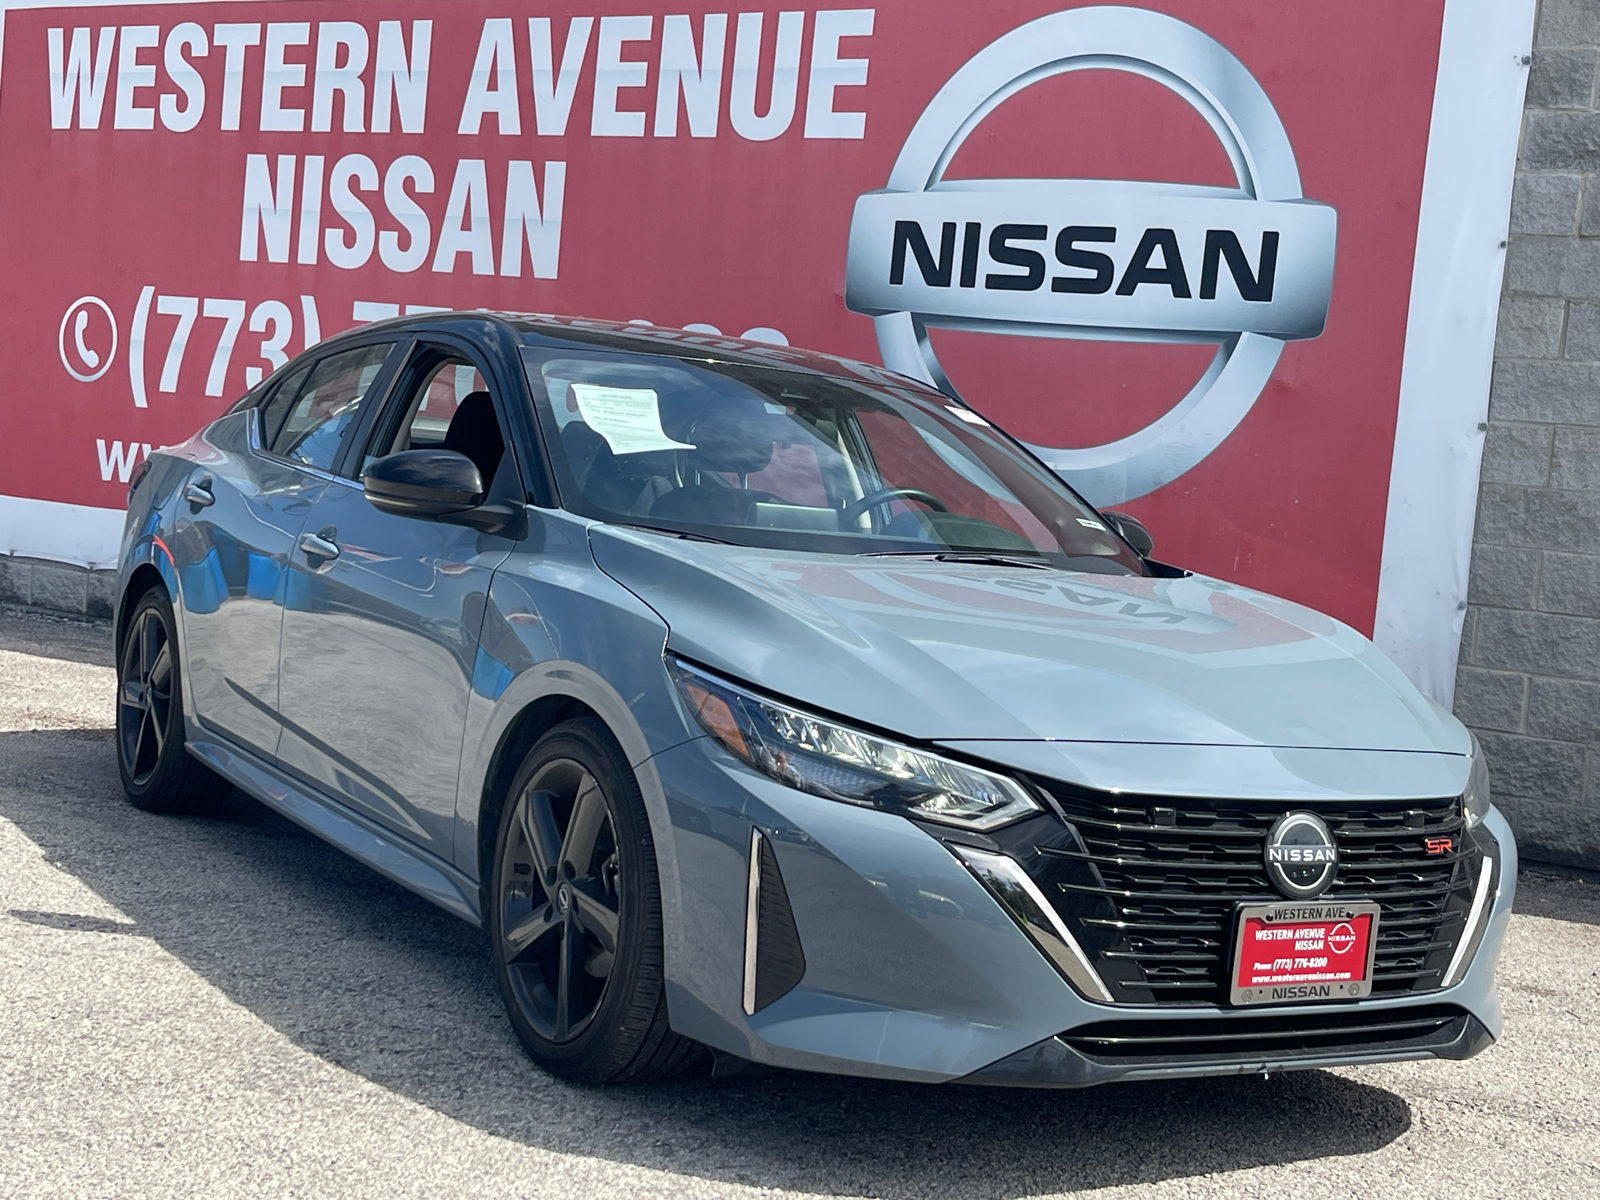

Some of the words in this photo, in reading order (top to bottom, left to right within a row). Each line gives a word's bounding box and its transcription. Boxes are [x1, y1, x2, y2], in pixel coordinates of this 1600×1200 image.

[47, 20, 433, 133] WESTERN
[457, 9, 876, 142] AVENUE
[239, 153, 567, 280] NISSAN
[889, 220, 1280, 302] NISSAN
[1426, 838, 1453, 855] SR
[1269, 848, 1335, 862] NISSAN
[1274, 908, 1323, 920] WESTERN
[1255, 929, 1293, 941] WESTERN
[1294, 928, 1325, 939] AVENUE
[1294, 940, 1324, 951] NISSAN
[1253, 962, 1272, 970] Phone:
[1273, 958, 1293, 972] (773)
[1294, 957, 1328, 969] 776-8200
[1251, 972, 1351, 983] www.westernavenissan.com
[1272, 985, 1330, 999] NISSAN
